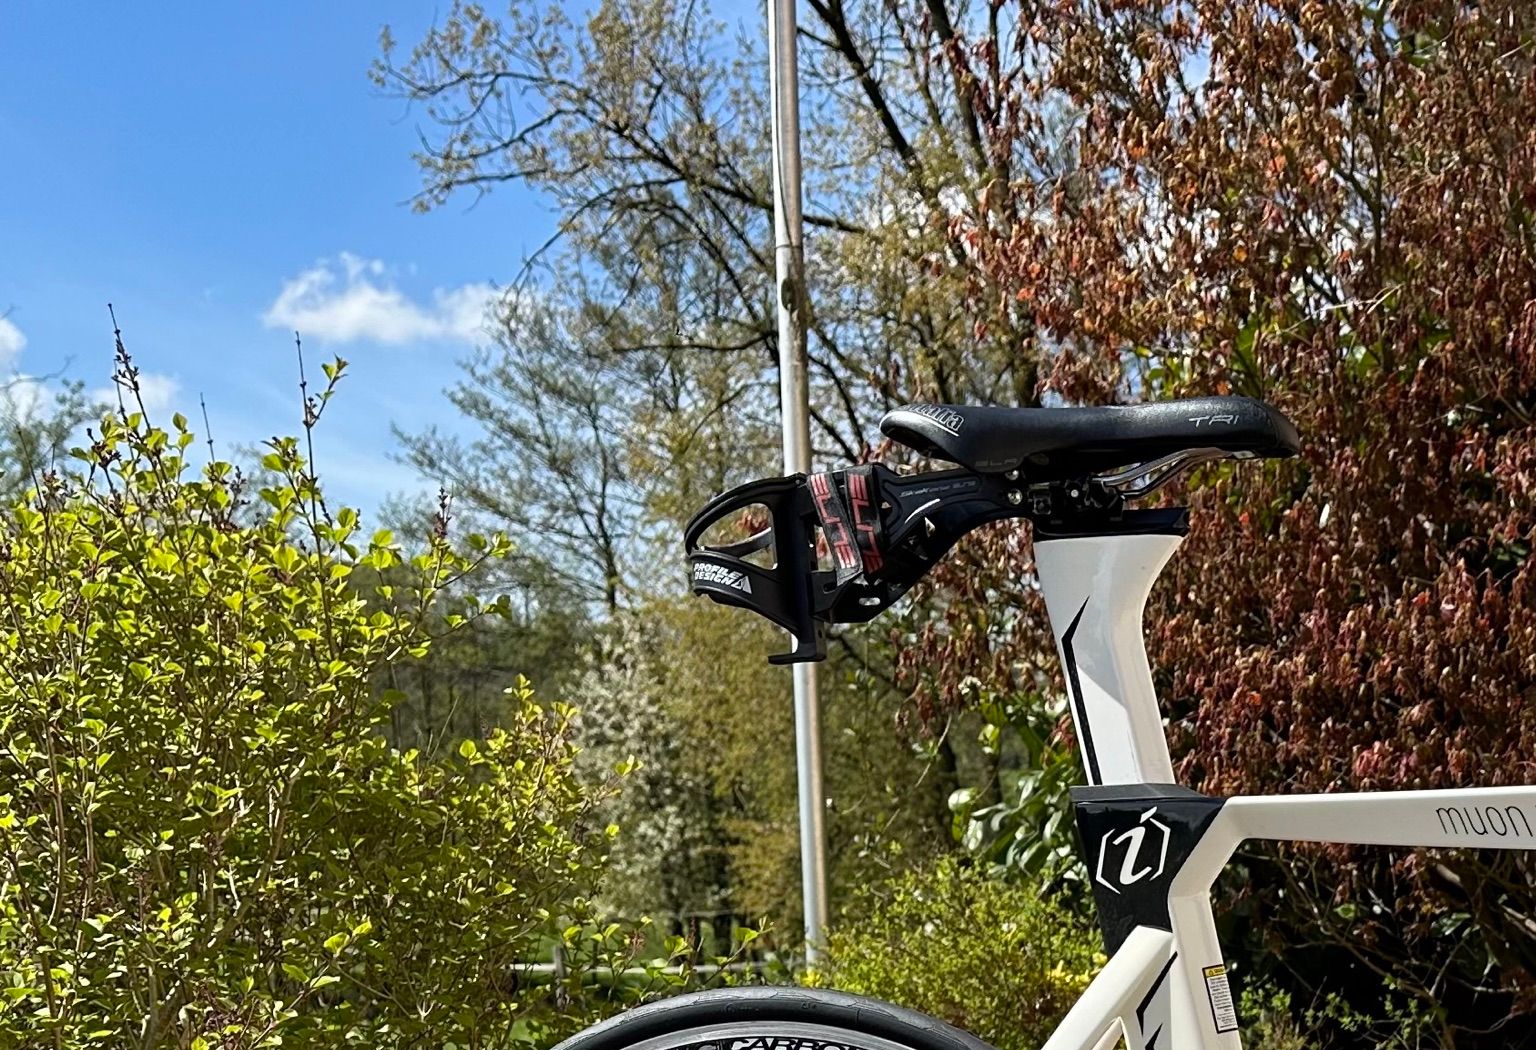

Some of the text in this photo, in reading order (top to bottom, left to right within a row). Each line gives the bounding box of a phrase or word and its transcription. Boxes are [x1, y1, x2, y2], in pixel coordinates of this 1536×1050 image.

[1188, 415, 1239, 428] TRI
[693, 562, 743, 579] PROFILE
[694, 571, 736, 588] DESIGN
